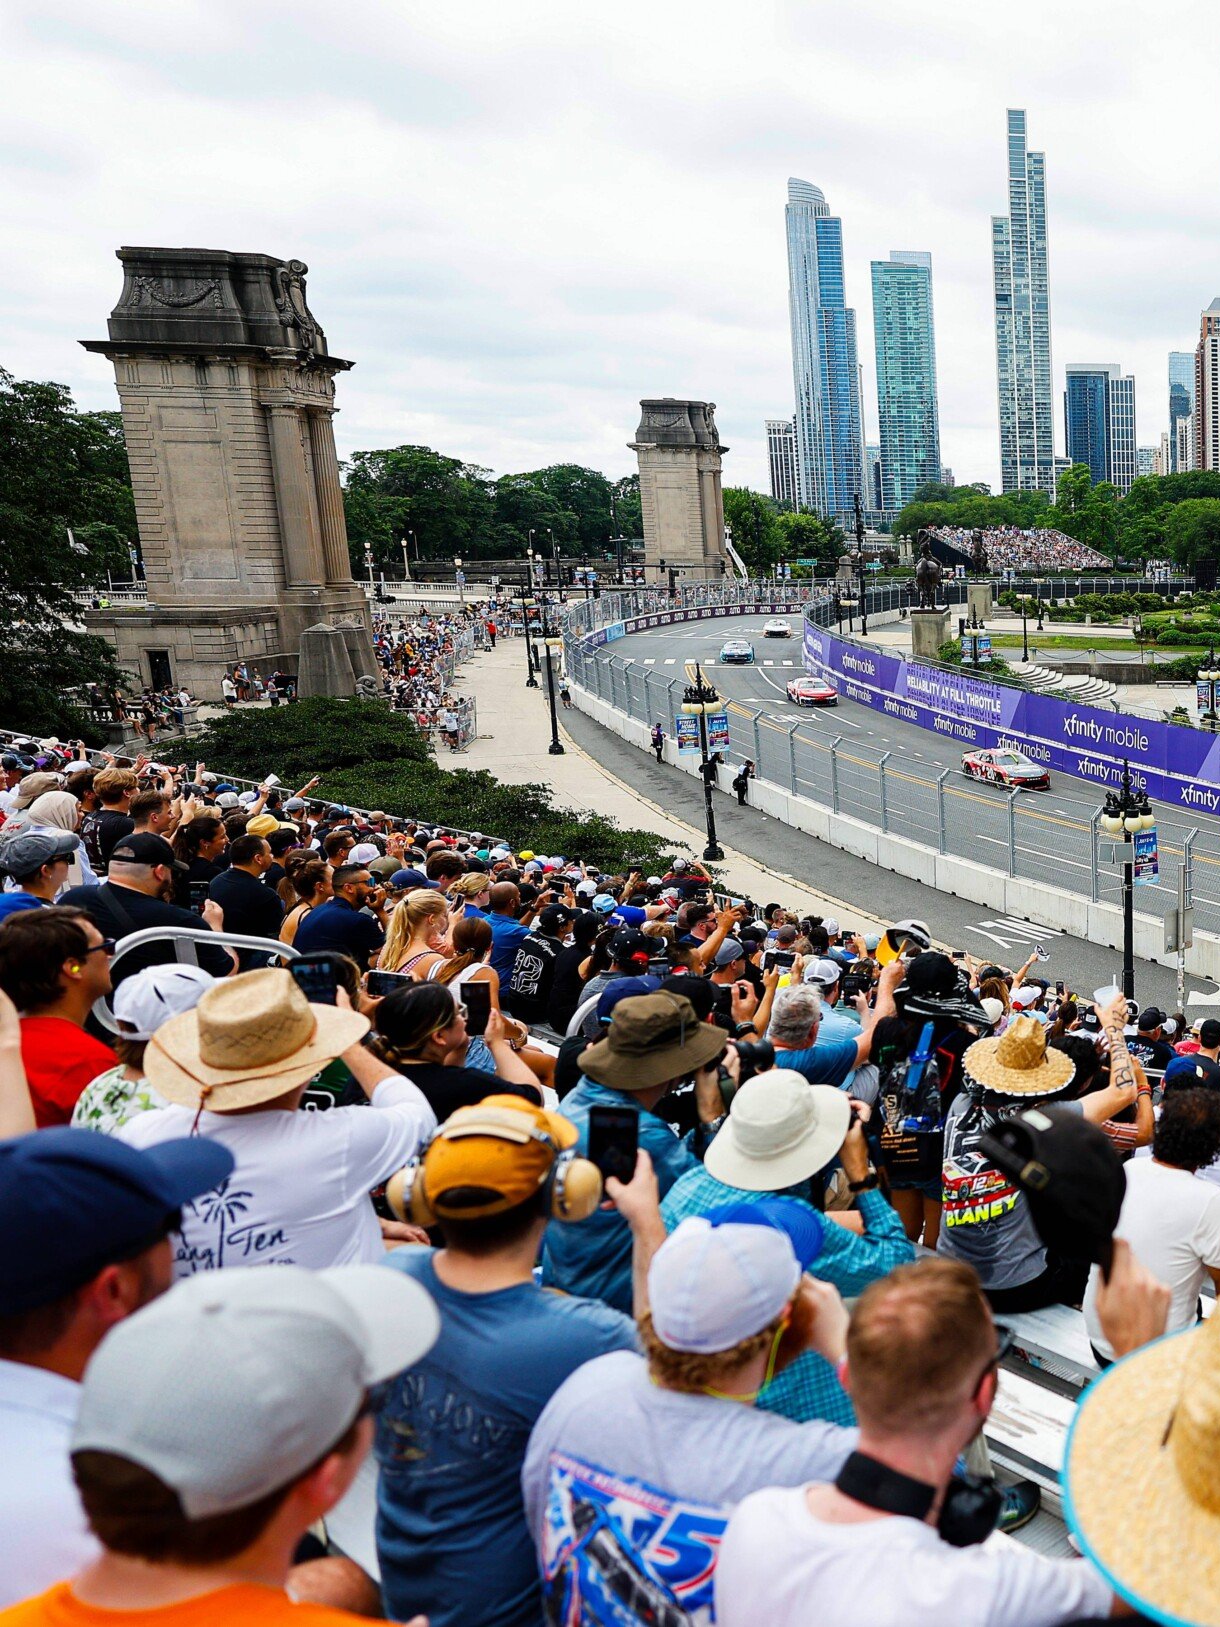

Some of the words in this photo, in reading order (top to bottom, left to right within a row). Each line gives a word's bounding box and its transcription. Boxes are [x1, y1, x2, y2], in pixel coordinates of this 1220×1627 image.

[941, 684, 951, 698] AT
[951, 686, 966, 704] FULL
[966, 692, 1001, 713] THROTTLE
[933, 715, 954, 731] xfinity
[954, 720, 976, 740] mobile
[1063, 713, 1104, 742] xfinity
[1105, 724, 1149, 751] mobile
[1023, 744, 1051, 762] mobile
[1078, 757, 1111, 781] xfinity
[1180, 784, 1220, 810] xfinity
[963, 916, 1066, 949] NLY
[972, 1176, 988, 1190] 12
[946, 1190, 1021, 1227] BLANEY
[226, 1222, 290, 1257] Ten
